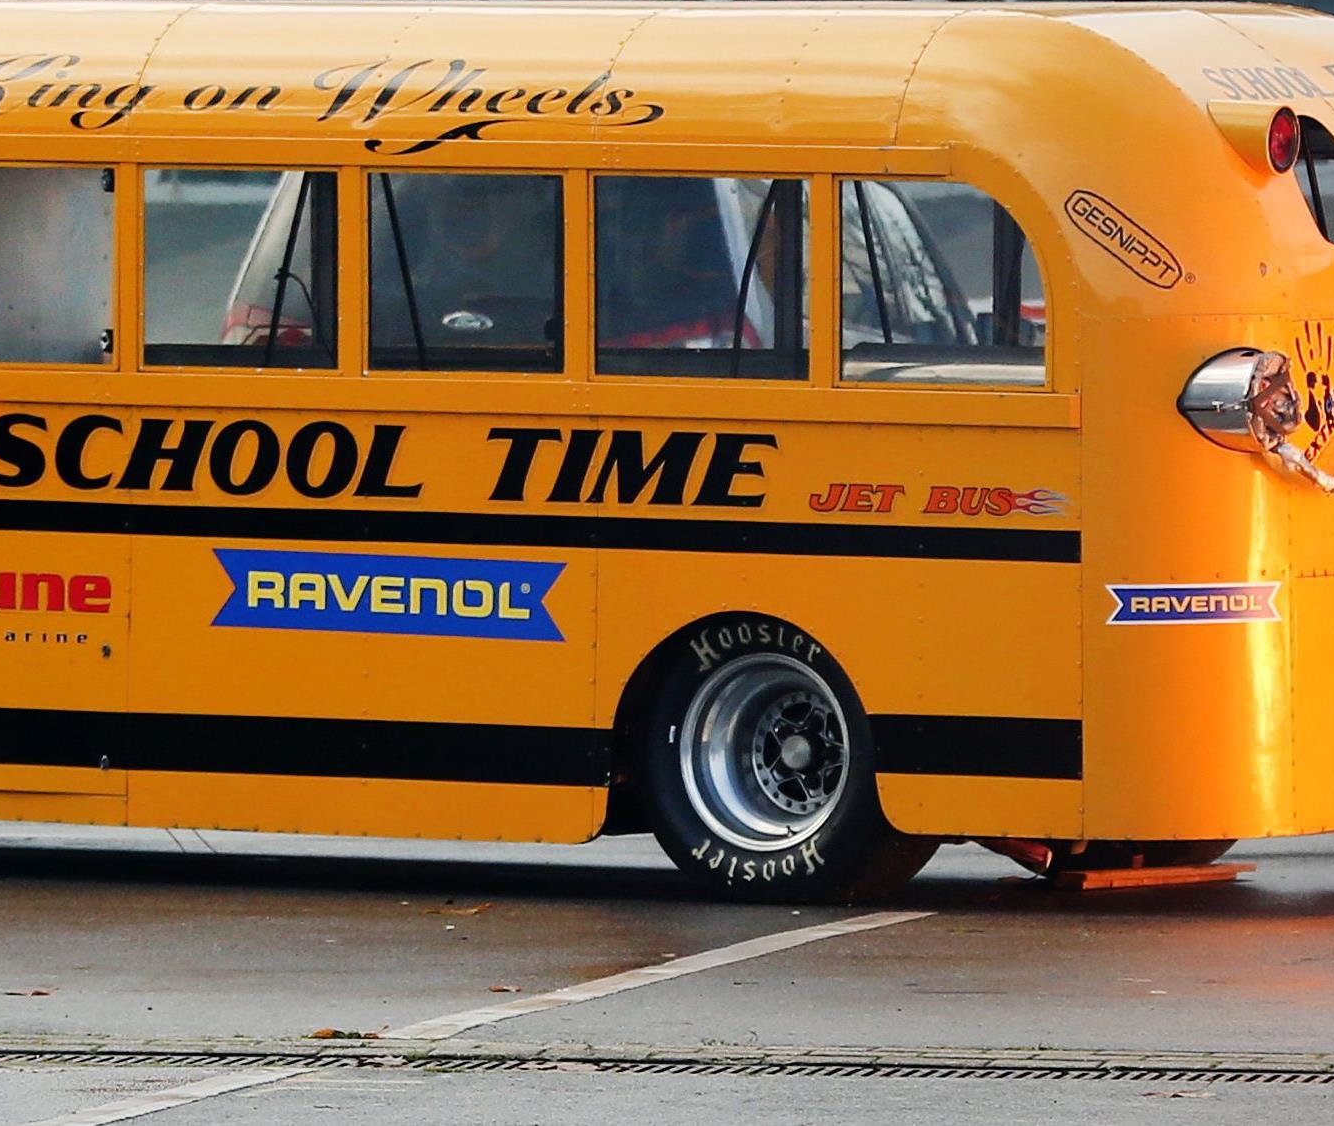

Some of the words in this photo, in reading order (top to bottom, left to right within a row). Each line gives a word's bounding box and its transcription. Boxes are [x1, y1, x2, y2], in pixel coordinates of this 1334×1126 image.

[184, 84, 282, 111] on
[314, 59, 665, 156] Wheels
[1072, 197, 1176, 278] GESNIPPT
[486, 427, 779, 508] TIME
[809, 483, 905, 513] JET
[922, 485, 1015, 516] BUS
